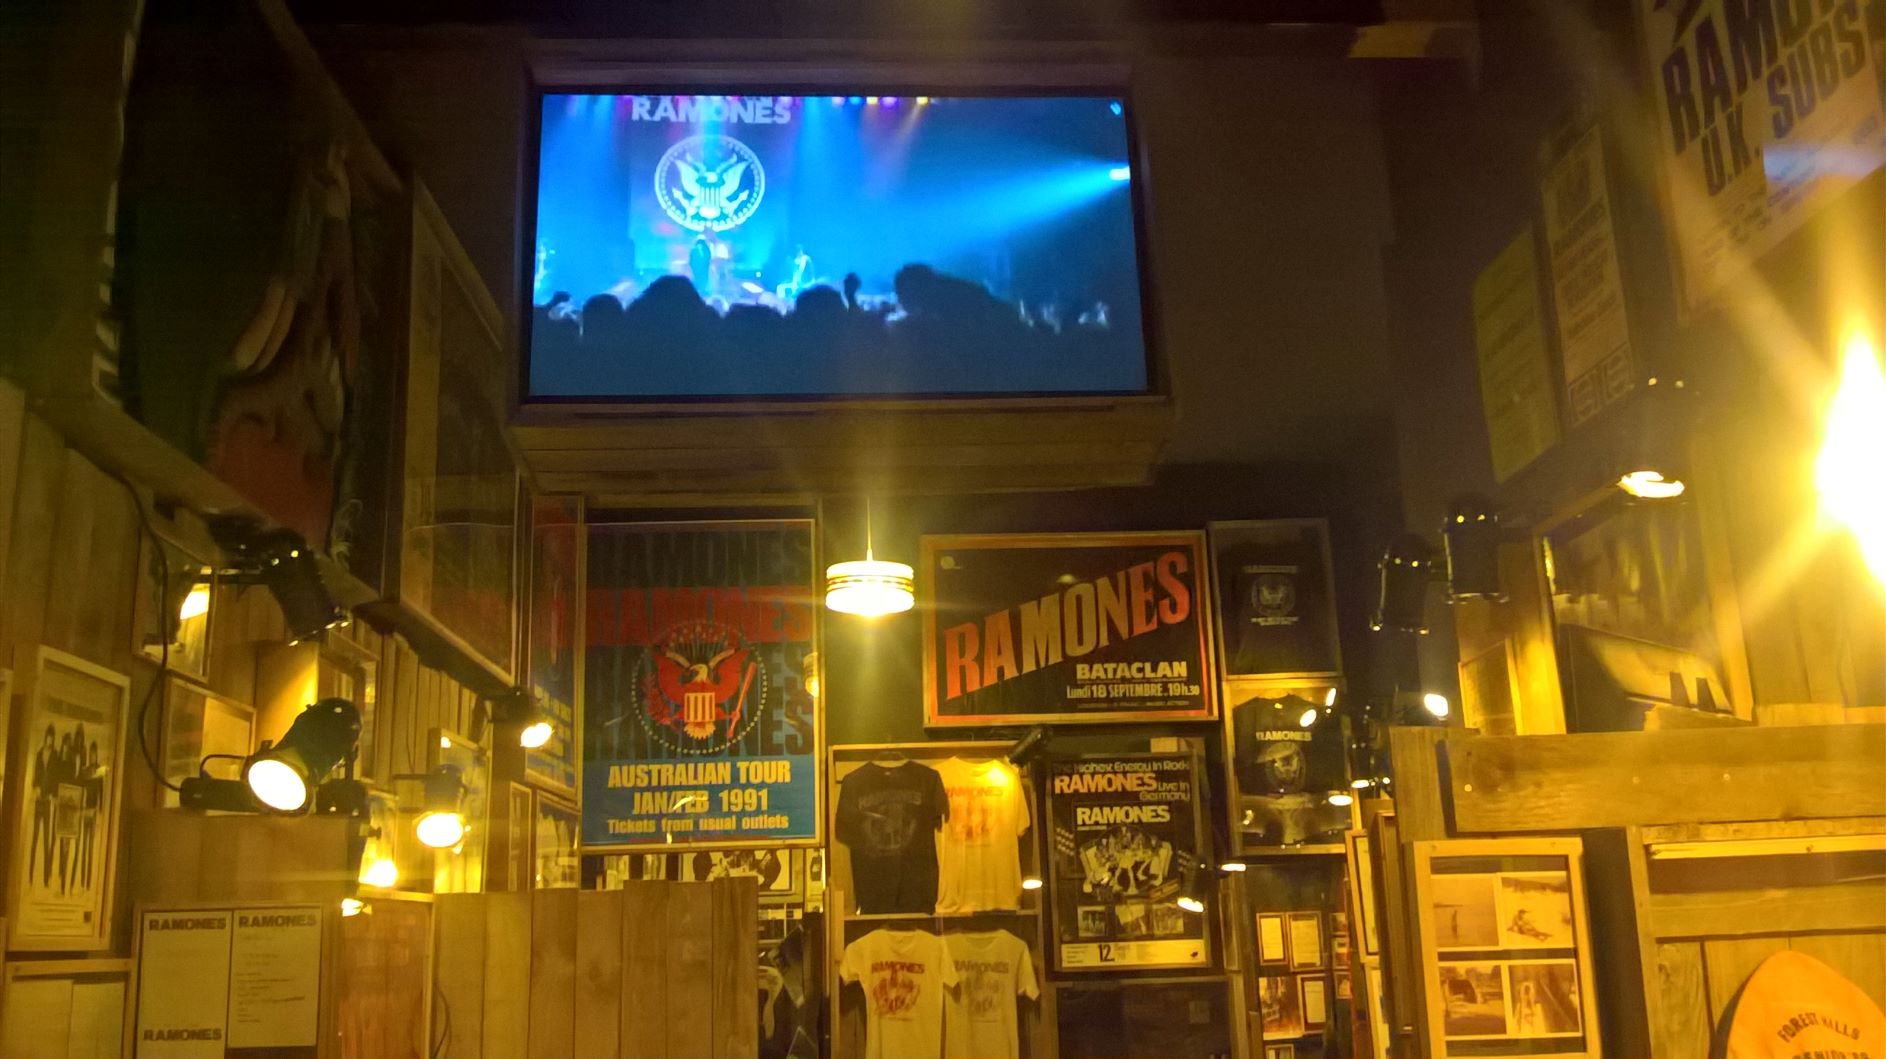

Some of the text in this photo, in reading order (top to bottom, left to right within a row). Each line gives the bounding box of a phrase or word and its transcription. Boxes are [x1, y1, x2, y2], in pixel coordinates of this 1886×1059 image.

[1662, 0, 1836, 156] RAM
[1767, 0, 1866, 139] SUBS
[631, 95, 792, 124] RAMONES
[943, 551, 1190, 701] RAMONES
[1076, 661, 1187, 679] BATACLAN
[1067, 684, 1091, 698] Lundi
[1092, 684, 1106, 698] 18
[1108, 683, 1163, 697] SEPTEMBRE
[608, 760, 791, 788] AUSTRALIAN TOUR
[1114, 760, 1151, 773] Energy
[1054, 773, 1157, 794] RAMONES
[1158, 782, 1178, 791] Live
[719, 788, 768, 812] 1991
[1139, 791, 1190, 802] Germany
[607, 814, 790, 834] Tickets from usual outlets
[1076, 806, 1170, 825] RAMONES
[149, 917, 226, 931] RAMONES
[238, 914, 317, 929] RAMONES
[143, 1028, 222, 1042] RAMONES
[1777, 1012, 1819, 1043] FOREST
